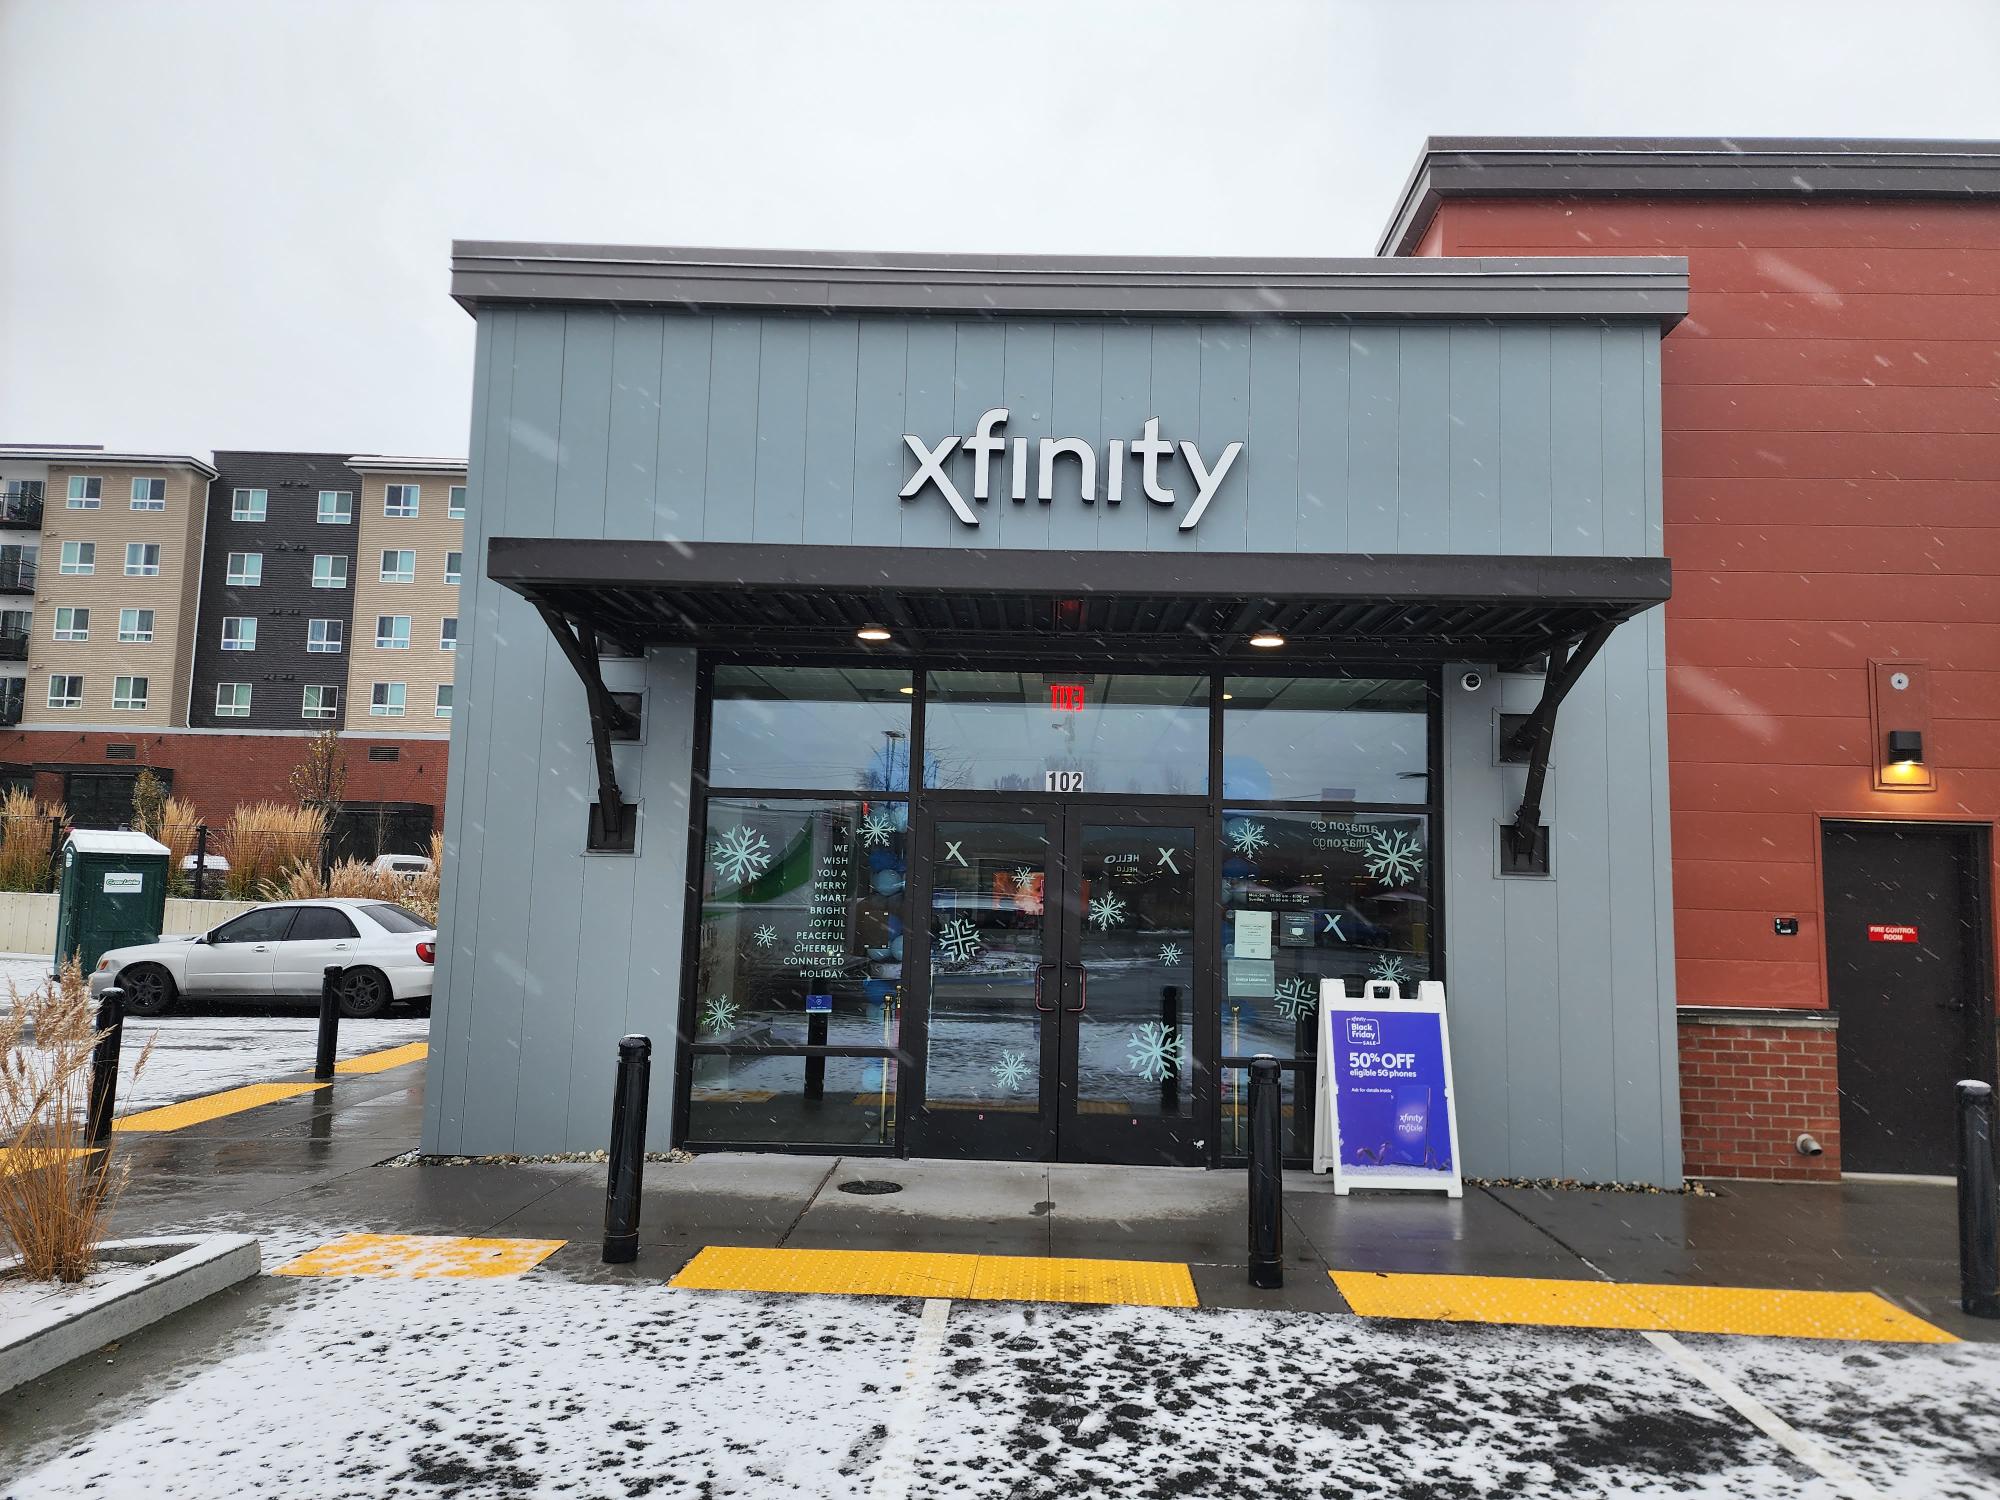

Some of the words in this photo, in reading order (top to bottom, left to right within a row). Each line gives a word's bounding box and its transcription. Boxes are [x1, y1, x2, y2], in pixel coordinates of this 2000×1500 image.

[898, 408, 1244, 531] xfinity
[1049, 772, 1082, 792] 102
[823, 857, 848, 865] WISH
[817, 869, 837, 877] YOU
[841, 869, 847, 877] A
[814, 882, 847, 890] MERRY
[814, 894, 847, 902] SMART
[810, 907, 846, 915] BRIGHT
[809, 919, 845, 927] JOYFUL
[796, 932, 845, 940] PEACEFUL
[794, 945, 844, 953] CHEERFUL
[783, 957, 844, 965] CONNECTED
[800, 970, 844, 978] HOLIDAY
[1351, 1023, 1373, 1031] Black
[1351, 1031, 1376, 1039] Friday
[1349, 1052, 1381, 1068] 50%
[1381, 1053, 1415, 1069] OFF
[1349, 1069, 1377, 1078] eligible
[1377, 1069, 1388, 1077] 5G
[1389, 1070, 1417, 1078] phones
[1400, 1113, 1423, 1123] xfinity
[1399, 1123, 1423, 1132] mobile
